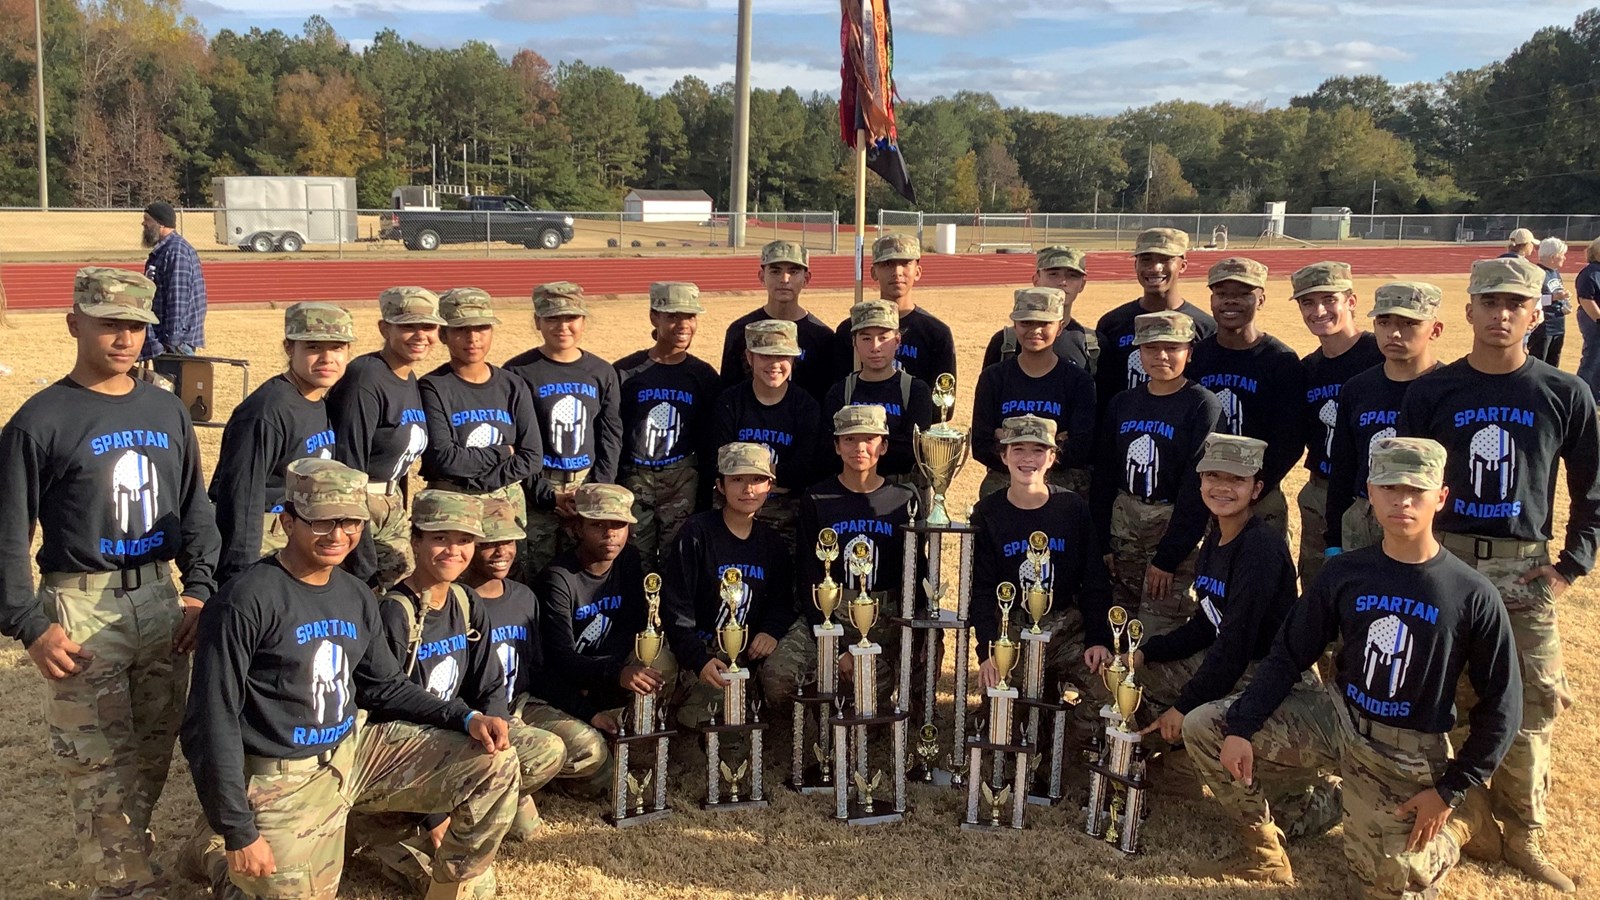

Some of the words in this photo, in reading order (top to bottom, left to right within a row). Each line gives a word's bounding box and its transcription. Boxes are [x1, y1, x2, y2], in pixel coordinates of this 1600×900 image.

[537, 381, 598, 399] SPARTAN
[1201, 374, 1257, 392] SPARTAN
[1307, 383, 1340, 401] SPART
[637, 388, 693, 405] SPARTAN
[1001, 399, 1061, 416] SPARTAN
[450, 408, 513, 427] SPARTAN
[1359, 410, 1400, 427] SPAR
[1454, 406, 1535, 433] SPARTAN
[738, 428, 792, 445] SPARTAN
[1120, 420, 1175, 440] SPARTAN
[89, 429, 170, 461] SPARTAN
[542, 454, 592, 470] RAIDERS
[1454, 498, 1521, 519] RAIDERS
[830, 519, 893, 536] SPARTAN
[1004, 537, 1065, 557] SPAAN
[718, 564, 764, 580] STAN
[1355, 594, 1440, 629] SPARTAN
[295, 618, 358, 649] SPARTAN
[491, 625, 527, 643] ARTAN
[1347, 684, 1409, 716] RAIDERS
